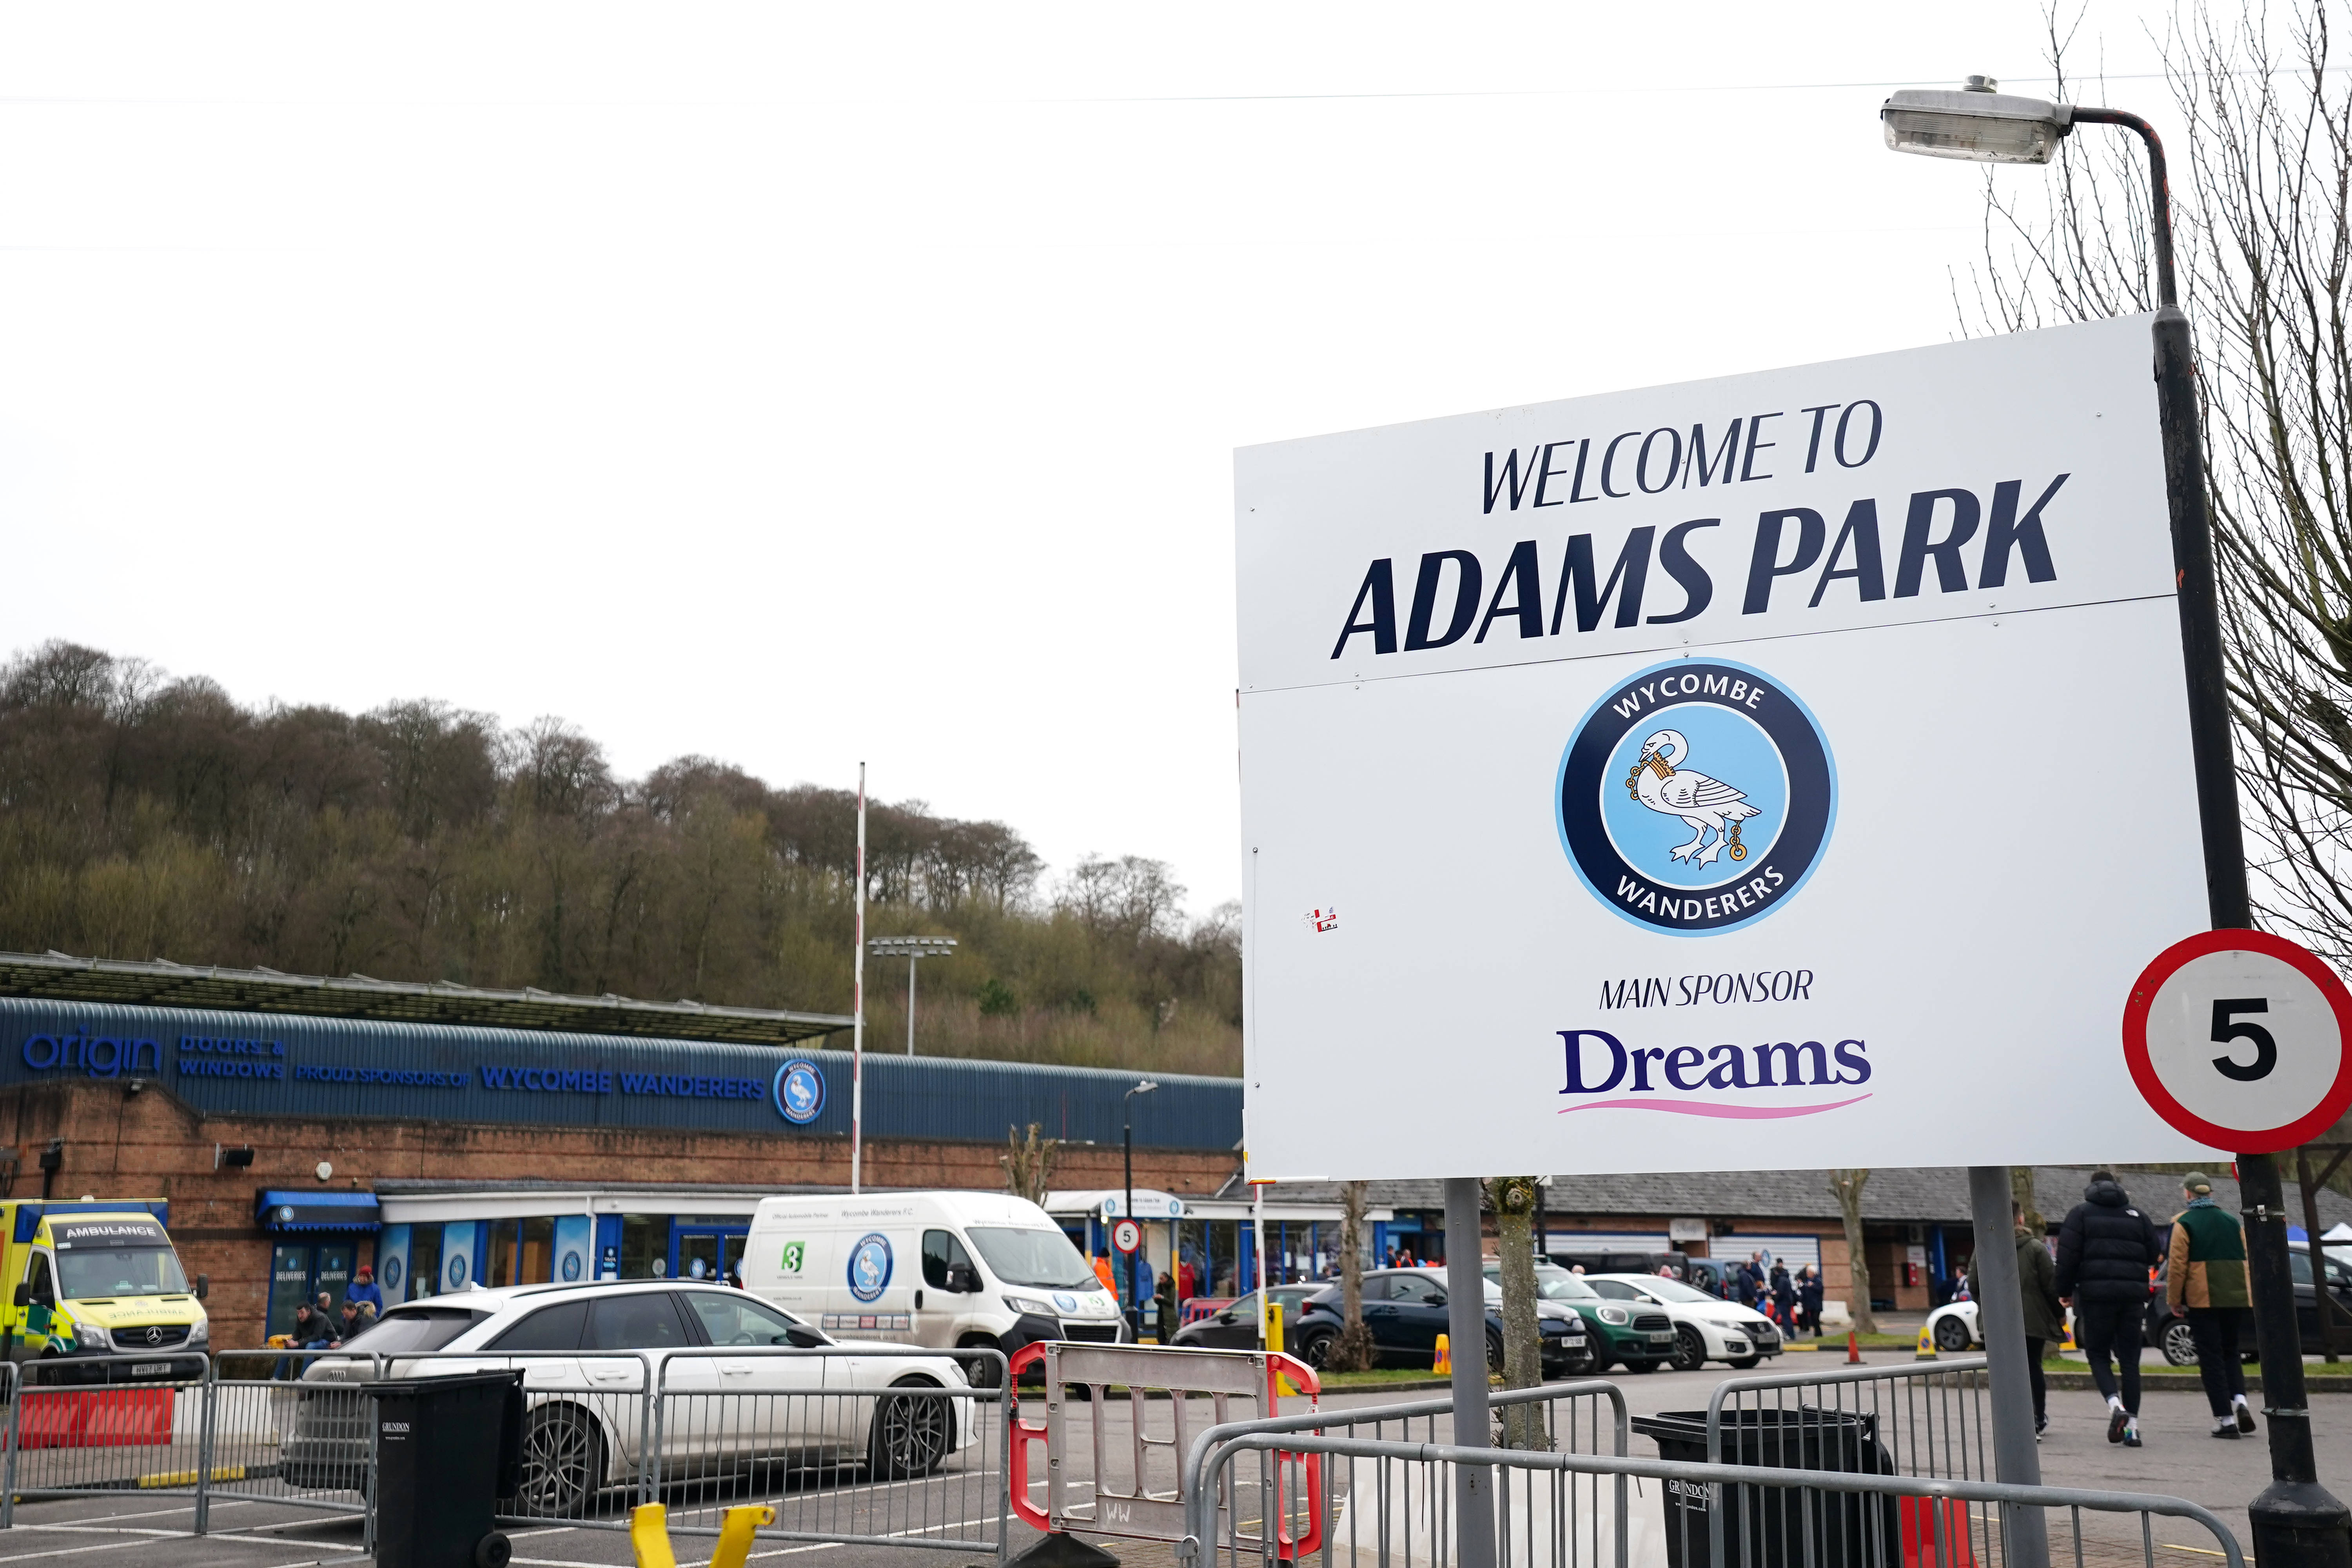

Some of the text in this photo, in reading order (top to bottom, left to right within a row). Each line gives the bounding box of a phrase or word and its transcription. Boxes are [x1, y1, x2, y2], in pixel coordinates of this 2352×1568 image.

[1484, 400, 1882, 514] WELCOME TO
[1330, 473, 2071, 659] ADAMS PARK
[1613, 674, 1764, 718] WYCOMBE
[1617, 866, 1783, 919] WANDERERS
[1599, 970, 1813, 1009] MAIN SPONSOR
[181, 1036, 285, 1056] DOORS &
[2211, 998, 2277, 1081] 5
[24, 1024, 160, 1078] origin
[180, 1060, 284, 1078] WINDOWS
[788, 1062, 815, 1075] WYCOMBE
[1557, 1029, 1871, 1094] Dreams
[296, 1065, 765, 1099] PROUD SPONSORS OF WYCOMBE WANDERERS
[786, 1106, 815, 1120] WANDERERS
[841, 1209, 869, 1219] Wycombe
[870, 1208, 901, 1217] Wanderers
[67, 1226, 156, 1239] AMBULANCE
[860, 1235, 887, 1247] WYCOMBE
[1123, 1230, 1131, 1243] 5
[276, 1271, 306, 1281] DELIVERIES
[321, 1271, 347, 1281] DELIVERIES
[853, 1286, 882, 1301] WANDERERS
[382, 1422, 409, 1431] GRUNDON
